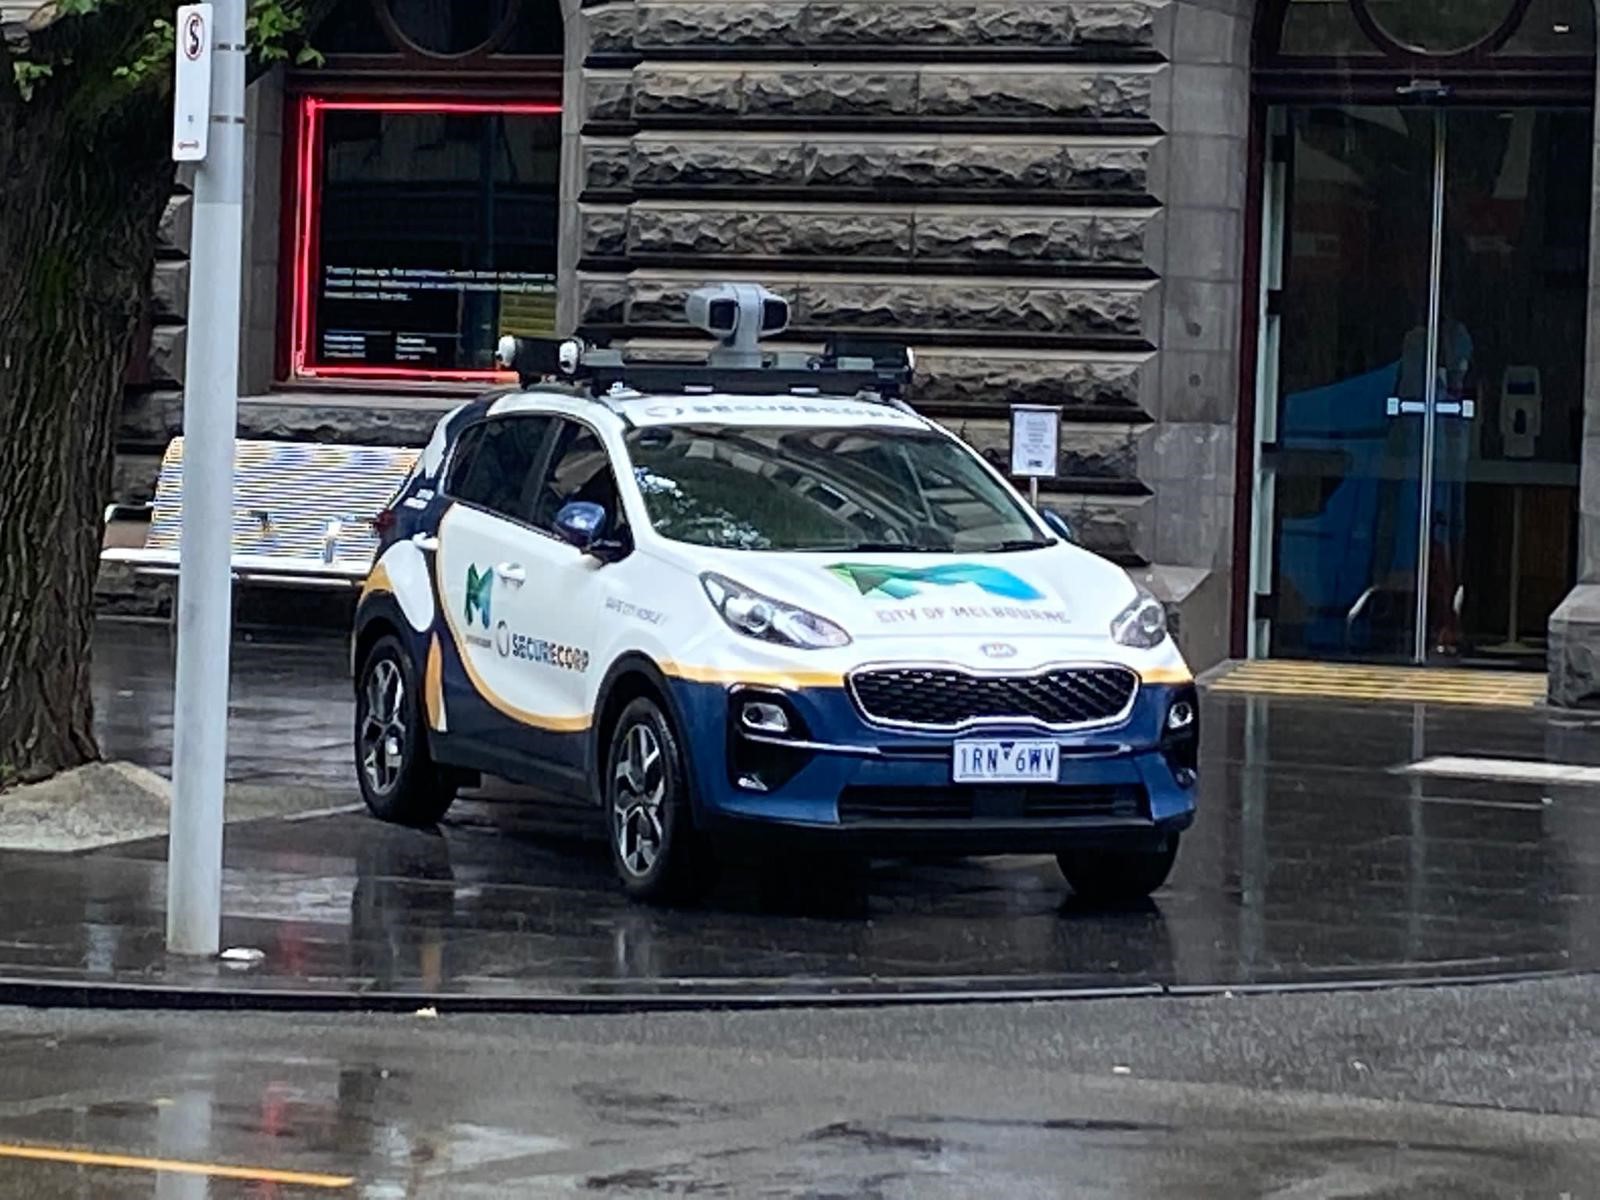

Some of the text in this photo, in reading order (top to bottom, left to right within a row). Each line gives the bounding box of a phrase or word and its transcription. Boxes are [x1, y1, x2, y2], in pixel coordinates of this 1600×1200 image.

[875, 604, 1072, 625] CITY OF MELBOURNE
[511, 633, 589, 673] SECURECORP
